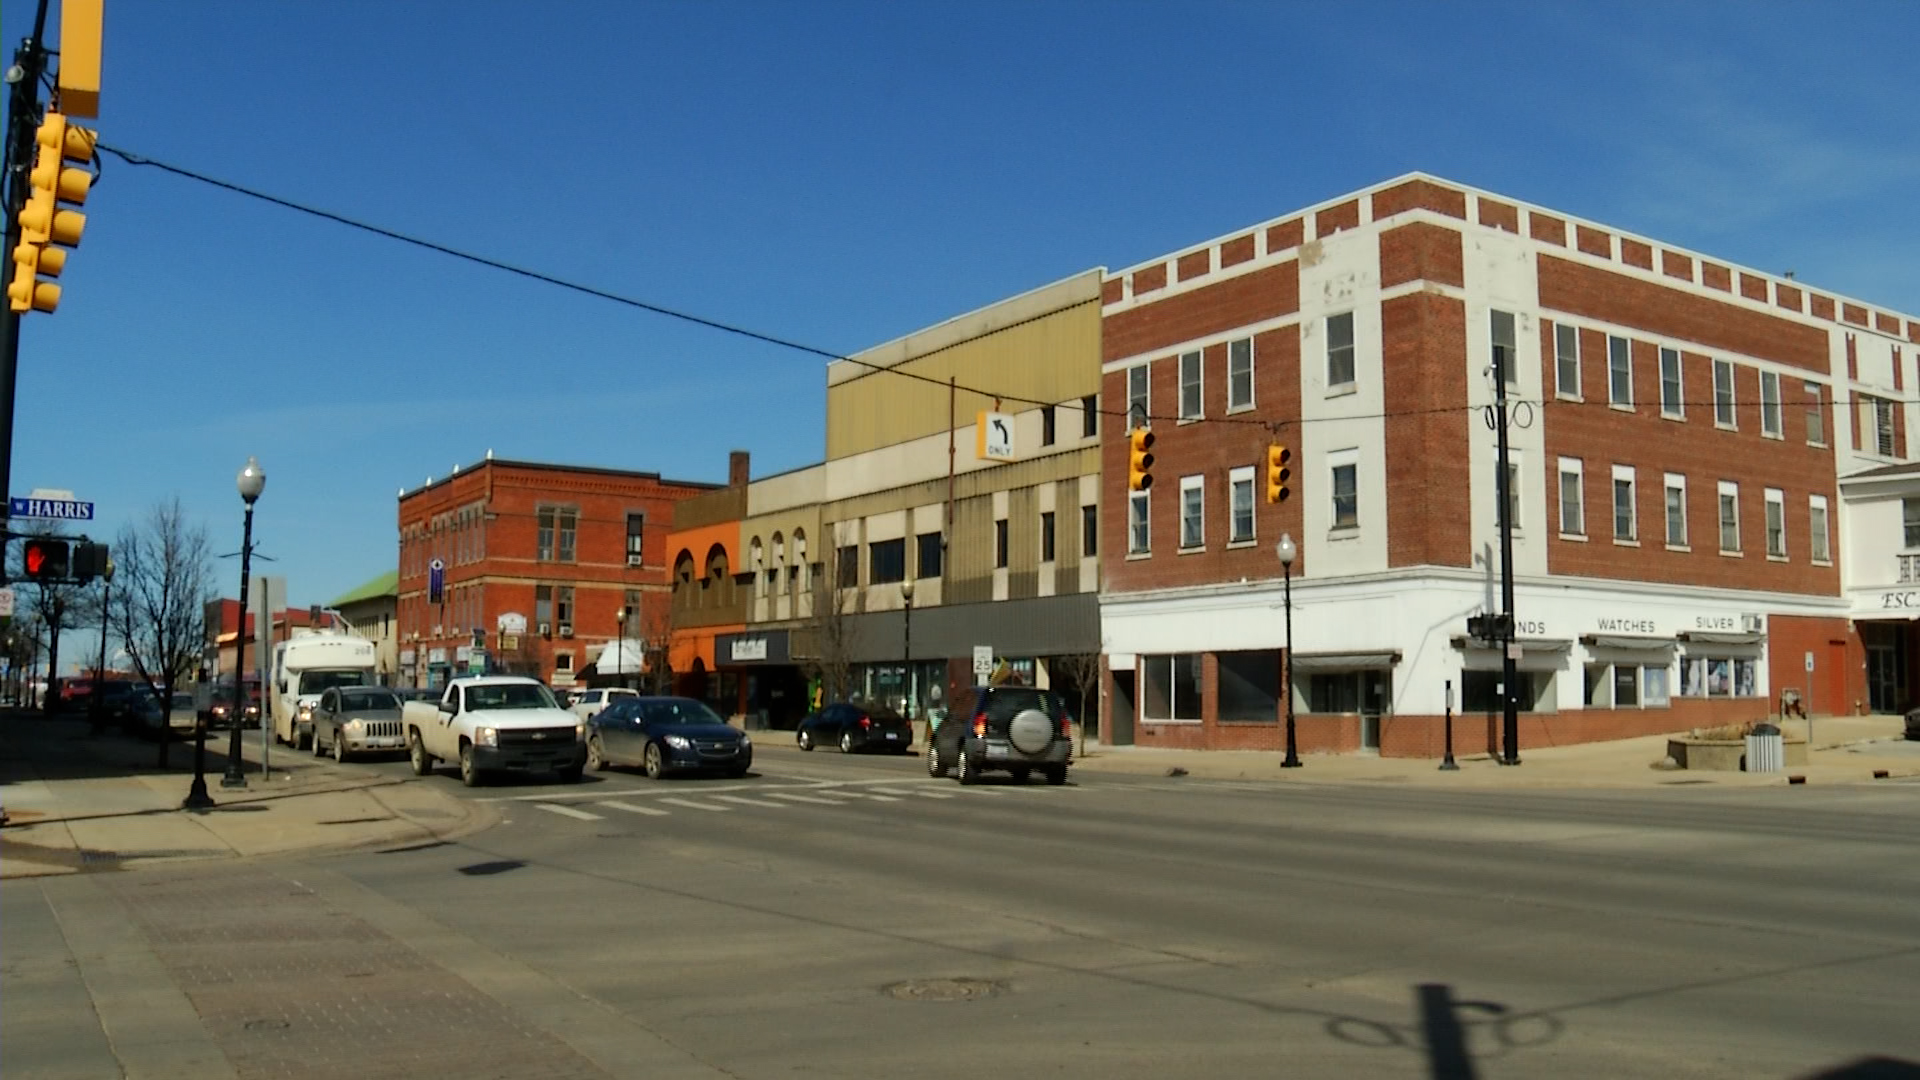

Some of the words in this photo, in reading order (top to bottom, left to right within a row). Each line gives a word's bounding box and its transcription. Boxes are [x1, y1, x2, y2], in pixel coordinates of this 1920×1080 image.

[988, 445, 1011, 456] ONLY
[28, 499, 90, 519] HARRIS
[1881, 591, 1920, 609] ESC
[1514, 621, 1546, 634] NDS
[1597, 617, 1655, 633] WATCHES
[1696, 616, 1734, 630] SILVER
[976, 660, 990, 670] 25
